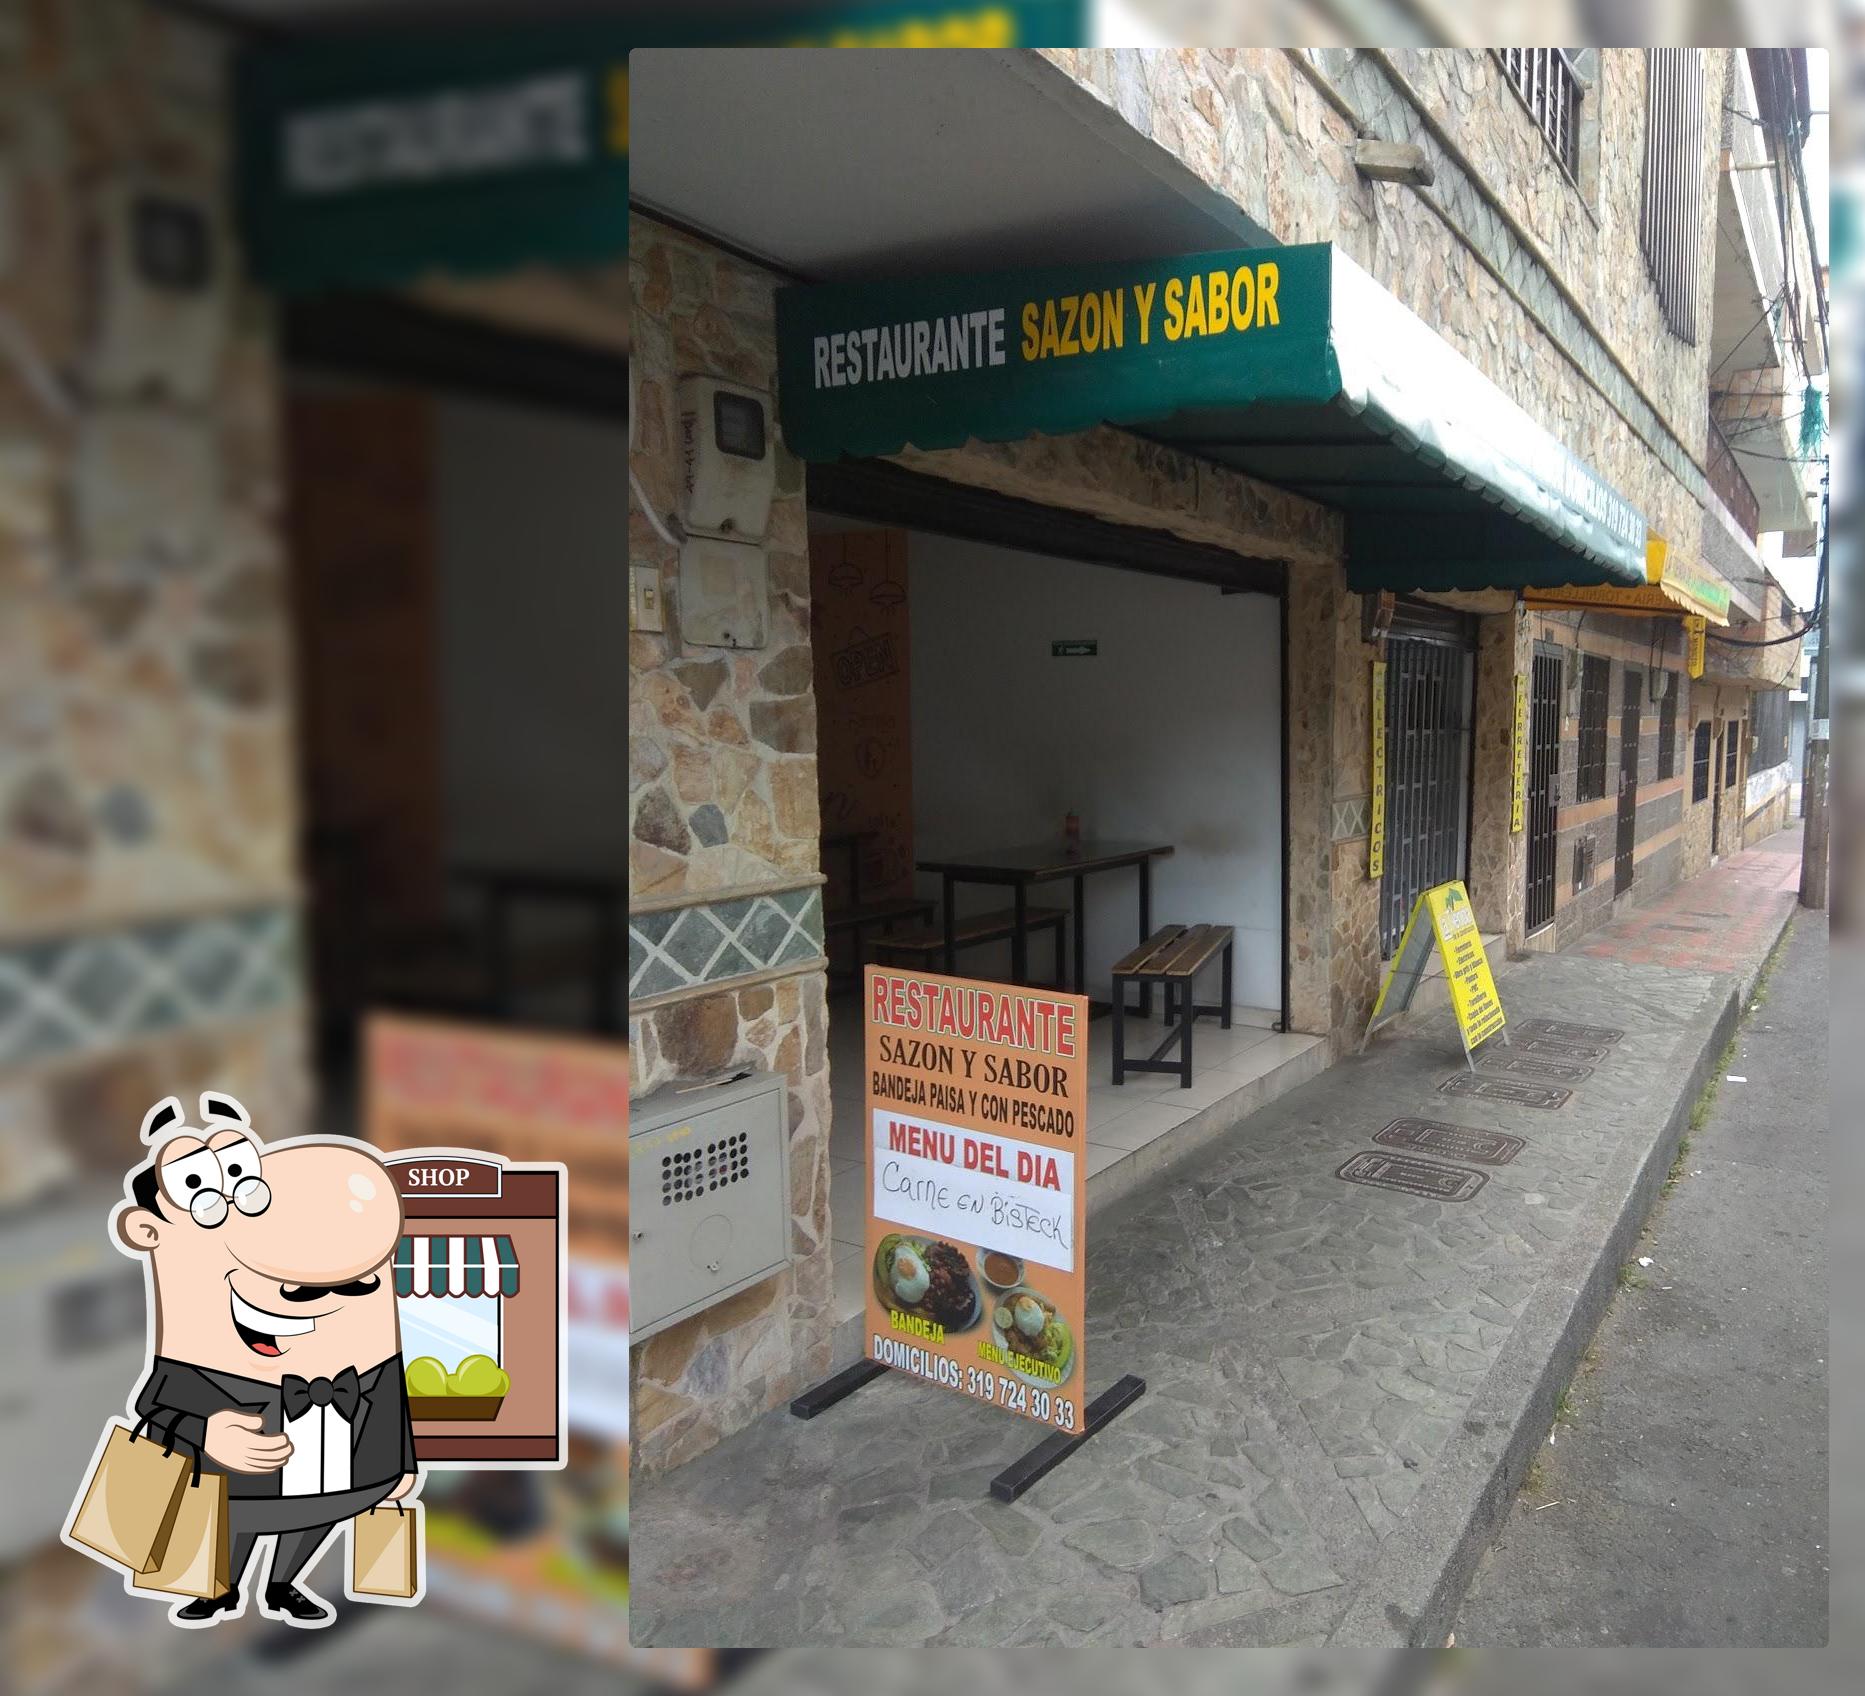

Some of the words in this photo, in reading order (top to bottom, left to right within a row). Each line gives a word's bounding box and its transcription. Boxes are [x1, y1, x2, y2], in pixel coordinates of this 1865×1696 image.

[814, 308, 1005, 389] RESTAURANTE
[1021, 289, 1124, 362] SAZON
[1133, 283, 1157, 345] Y
[1164, 262, 1280, 341] SABOR
[871, 974, 1076, 1058] RESTAURANTE
[880, 1035, 953, 1074] SAZON
[962, 1051, 975, 1078] Y
[984, 1054, 1069, 1098] SABOR
[873, 1071, 926, 1104] BANDEJA
[930, 1083, 965, 1115] PAISA
[968, 1091, 978, 1116] Y
[981, 1094, 1008, 1124] CON
[1013, 1100, 1074, 1138] PESCADO
[889, 1121, 955, 1165] MENU
[963, 1138, 1009, 1179] DEL
[1017, 1150, 1061, 1192] DIA
[890, 1310, 945, 1345] BANDEJA
[873, 1333, 963, 1391] DOMICILIOS:
[967, 1365, 994, 1401] 319
[998, 1376, 1027, 1413] 724
[1031, 1388, 1050, 1421] 30
[1055, 1396, 1075, 1430] 33
[977, 1341, 1005, 1365] MENU
[1007, 1351, 1062, 1386] EJECUTIVO
